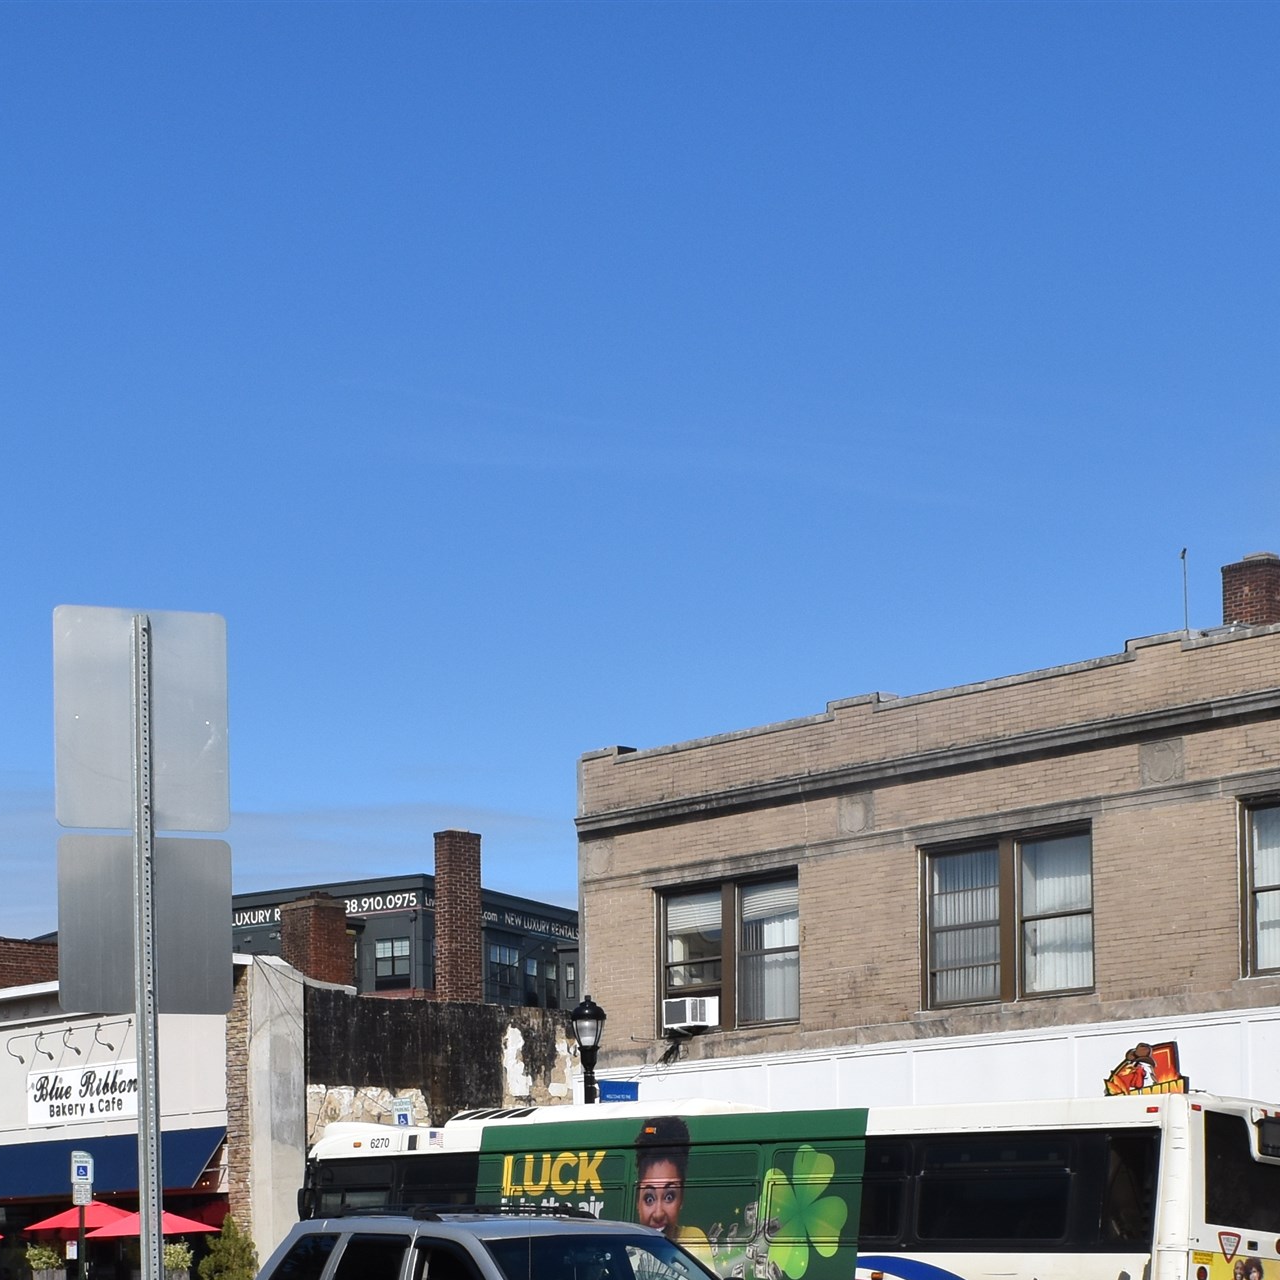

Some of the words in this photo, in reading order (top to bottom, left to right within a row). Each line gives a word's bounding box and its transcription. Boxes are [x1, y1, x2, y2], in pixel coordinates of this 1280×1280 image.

[505, 912, 522, 926] NEW
[523, 918, 550, 933] LUXURY
[551, 923, 579, 940] RENTALS
[34, 1075, 72, 1103] Blue
[79, 1069, 138, 1098] Ribbon
[49, 1102, 85, 1117] Bakery
[89, 1102, 95, 1113] &
[98, 1097, 123, 1112] Cafe
[370, 1138, 390, 1149] 6270
[502, 1150, 607, 1196] LUCK
